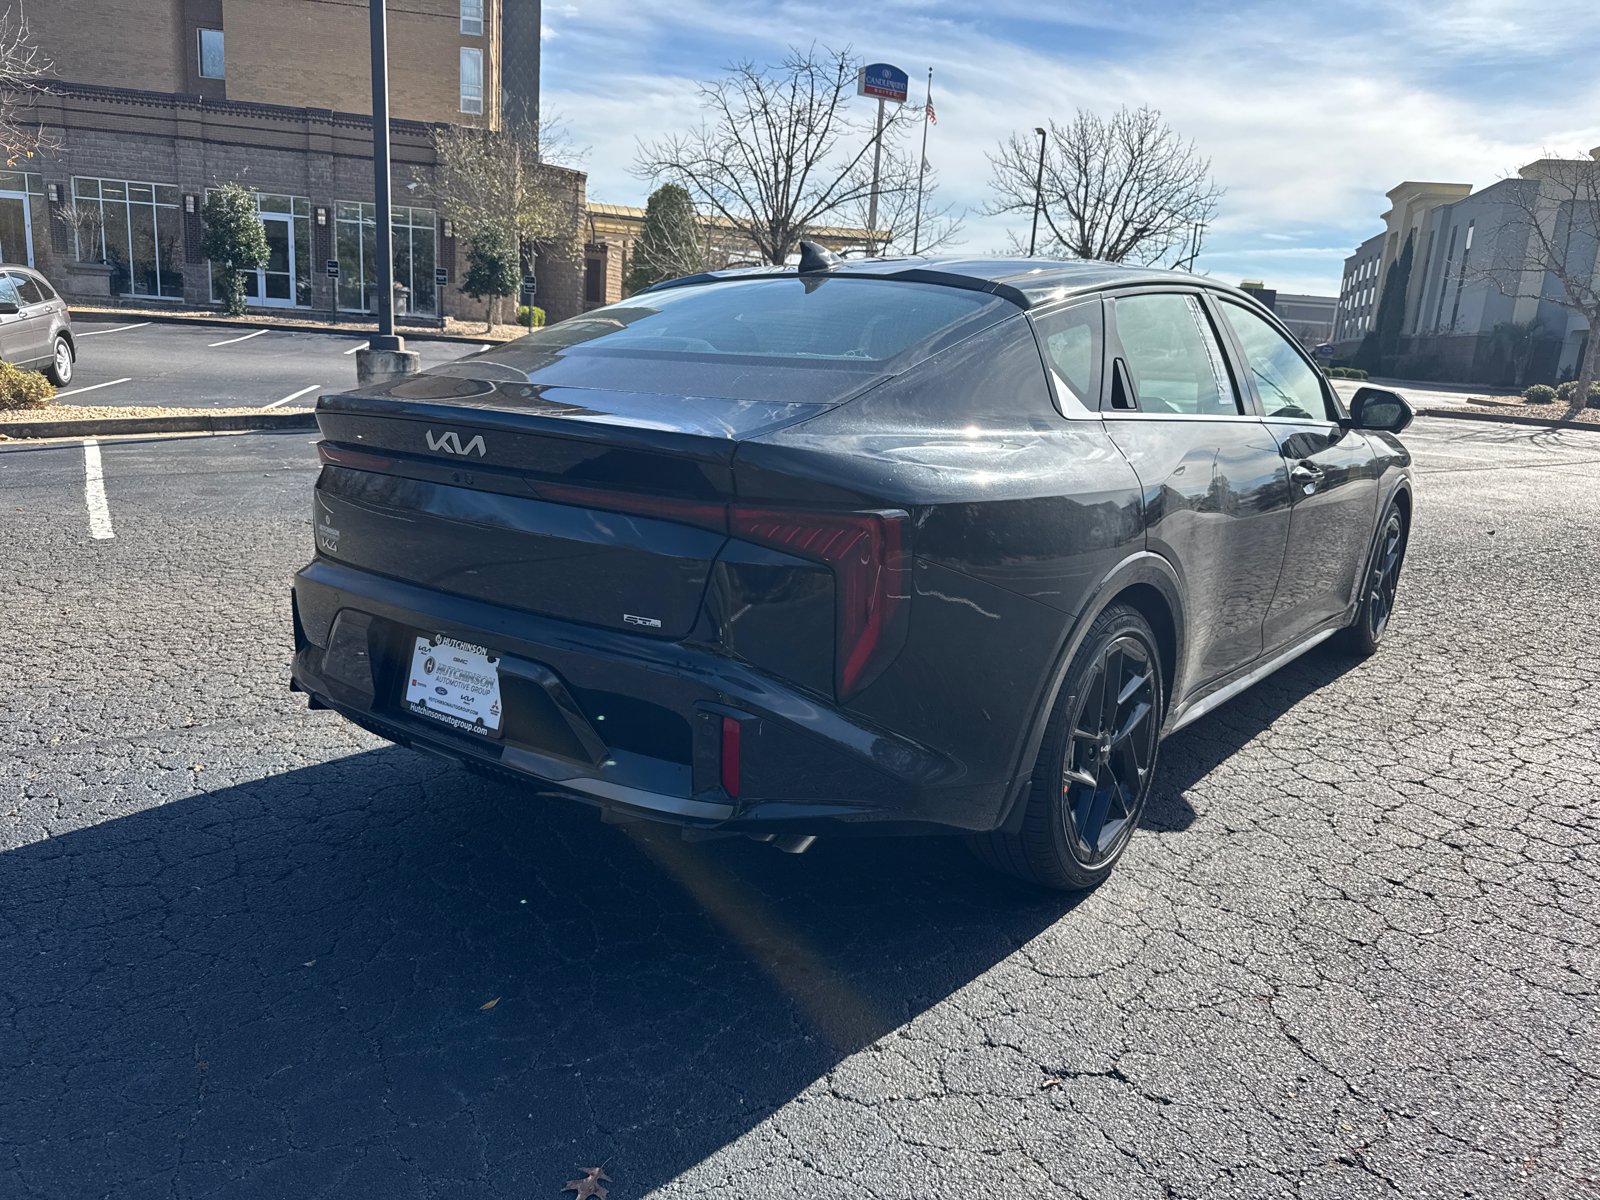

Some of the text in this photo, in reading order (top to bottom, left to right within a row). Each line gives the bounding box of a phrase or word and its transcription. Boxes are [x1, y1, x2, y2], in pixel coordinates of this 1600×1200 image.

[866, 76, 906, 90] CANDLEWOOD
[874, 88, 898, 97] SUITES
[426, 430, 486, 457] KIA
[322, 537, 338, 552] K4
[443, 636, 488, 656] HUTCHINSON
[435, 676, 490, 696] AUTOMOTIVE GROUP
[436, 663, 495, 689] HUTCHINSON
[410, 703, 488, 735] Hutchinsonautogroup.com
